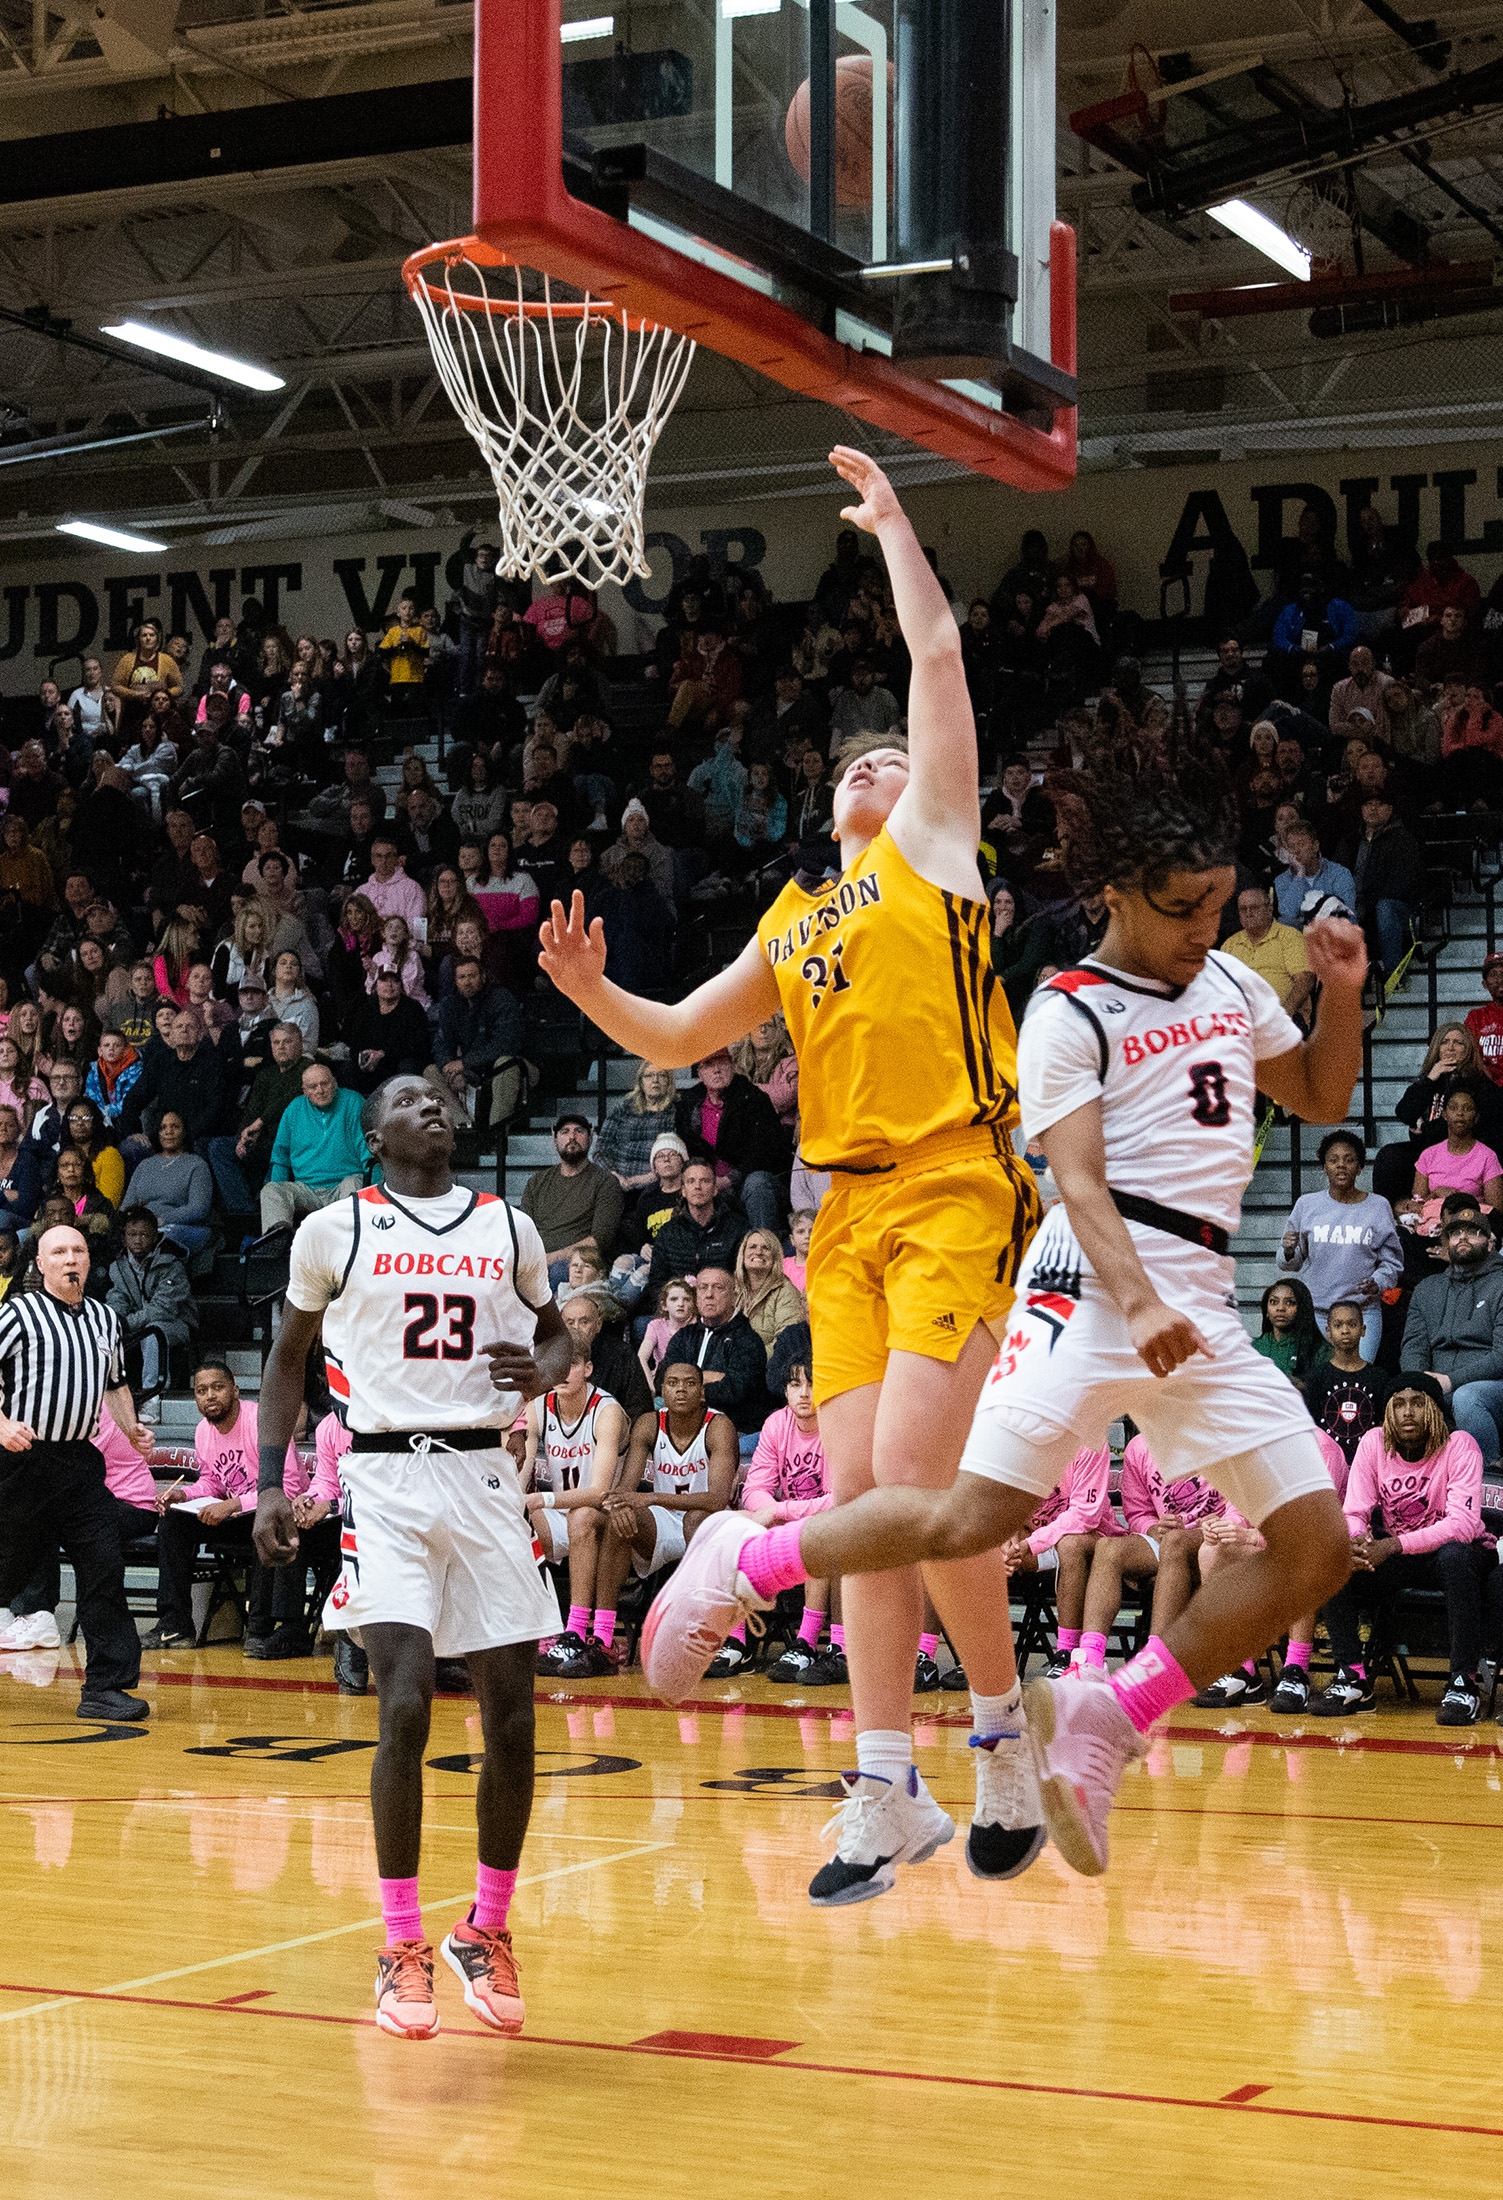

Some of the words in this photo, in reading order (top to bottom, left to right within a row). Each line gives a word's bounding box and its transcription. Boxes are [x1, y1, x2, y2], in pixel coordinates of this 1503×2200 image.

[1159, 467, 1503, 578] ADUL
[767, 873, 881, 967] DAVISON
[1187, 1060, 1232, 1128] 0
[1313, 1224, 1373, 1245] MAMA
[373, 1252, 504, 1281] BOBCATS
[403, 1292, 476, 1361] 23
[560, 1465, 580, 1491] 11
[1086, 1488, 1098, 1504] 15
[1464, 1496, 1473, 1511] 4
